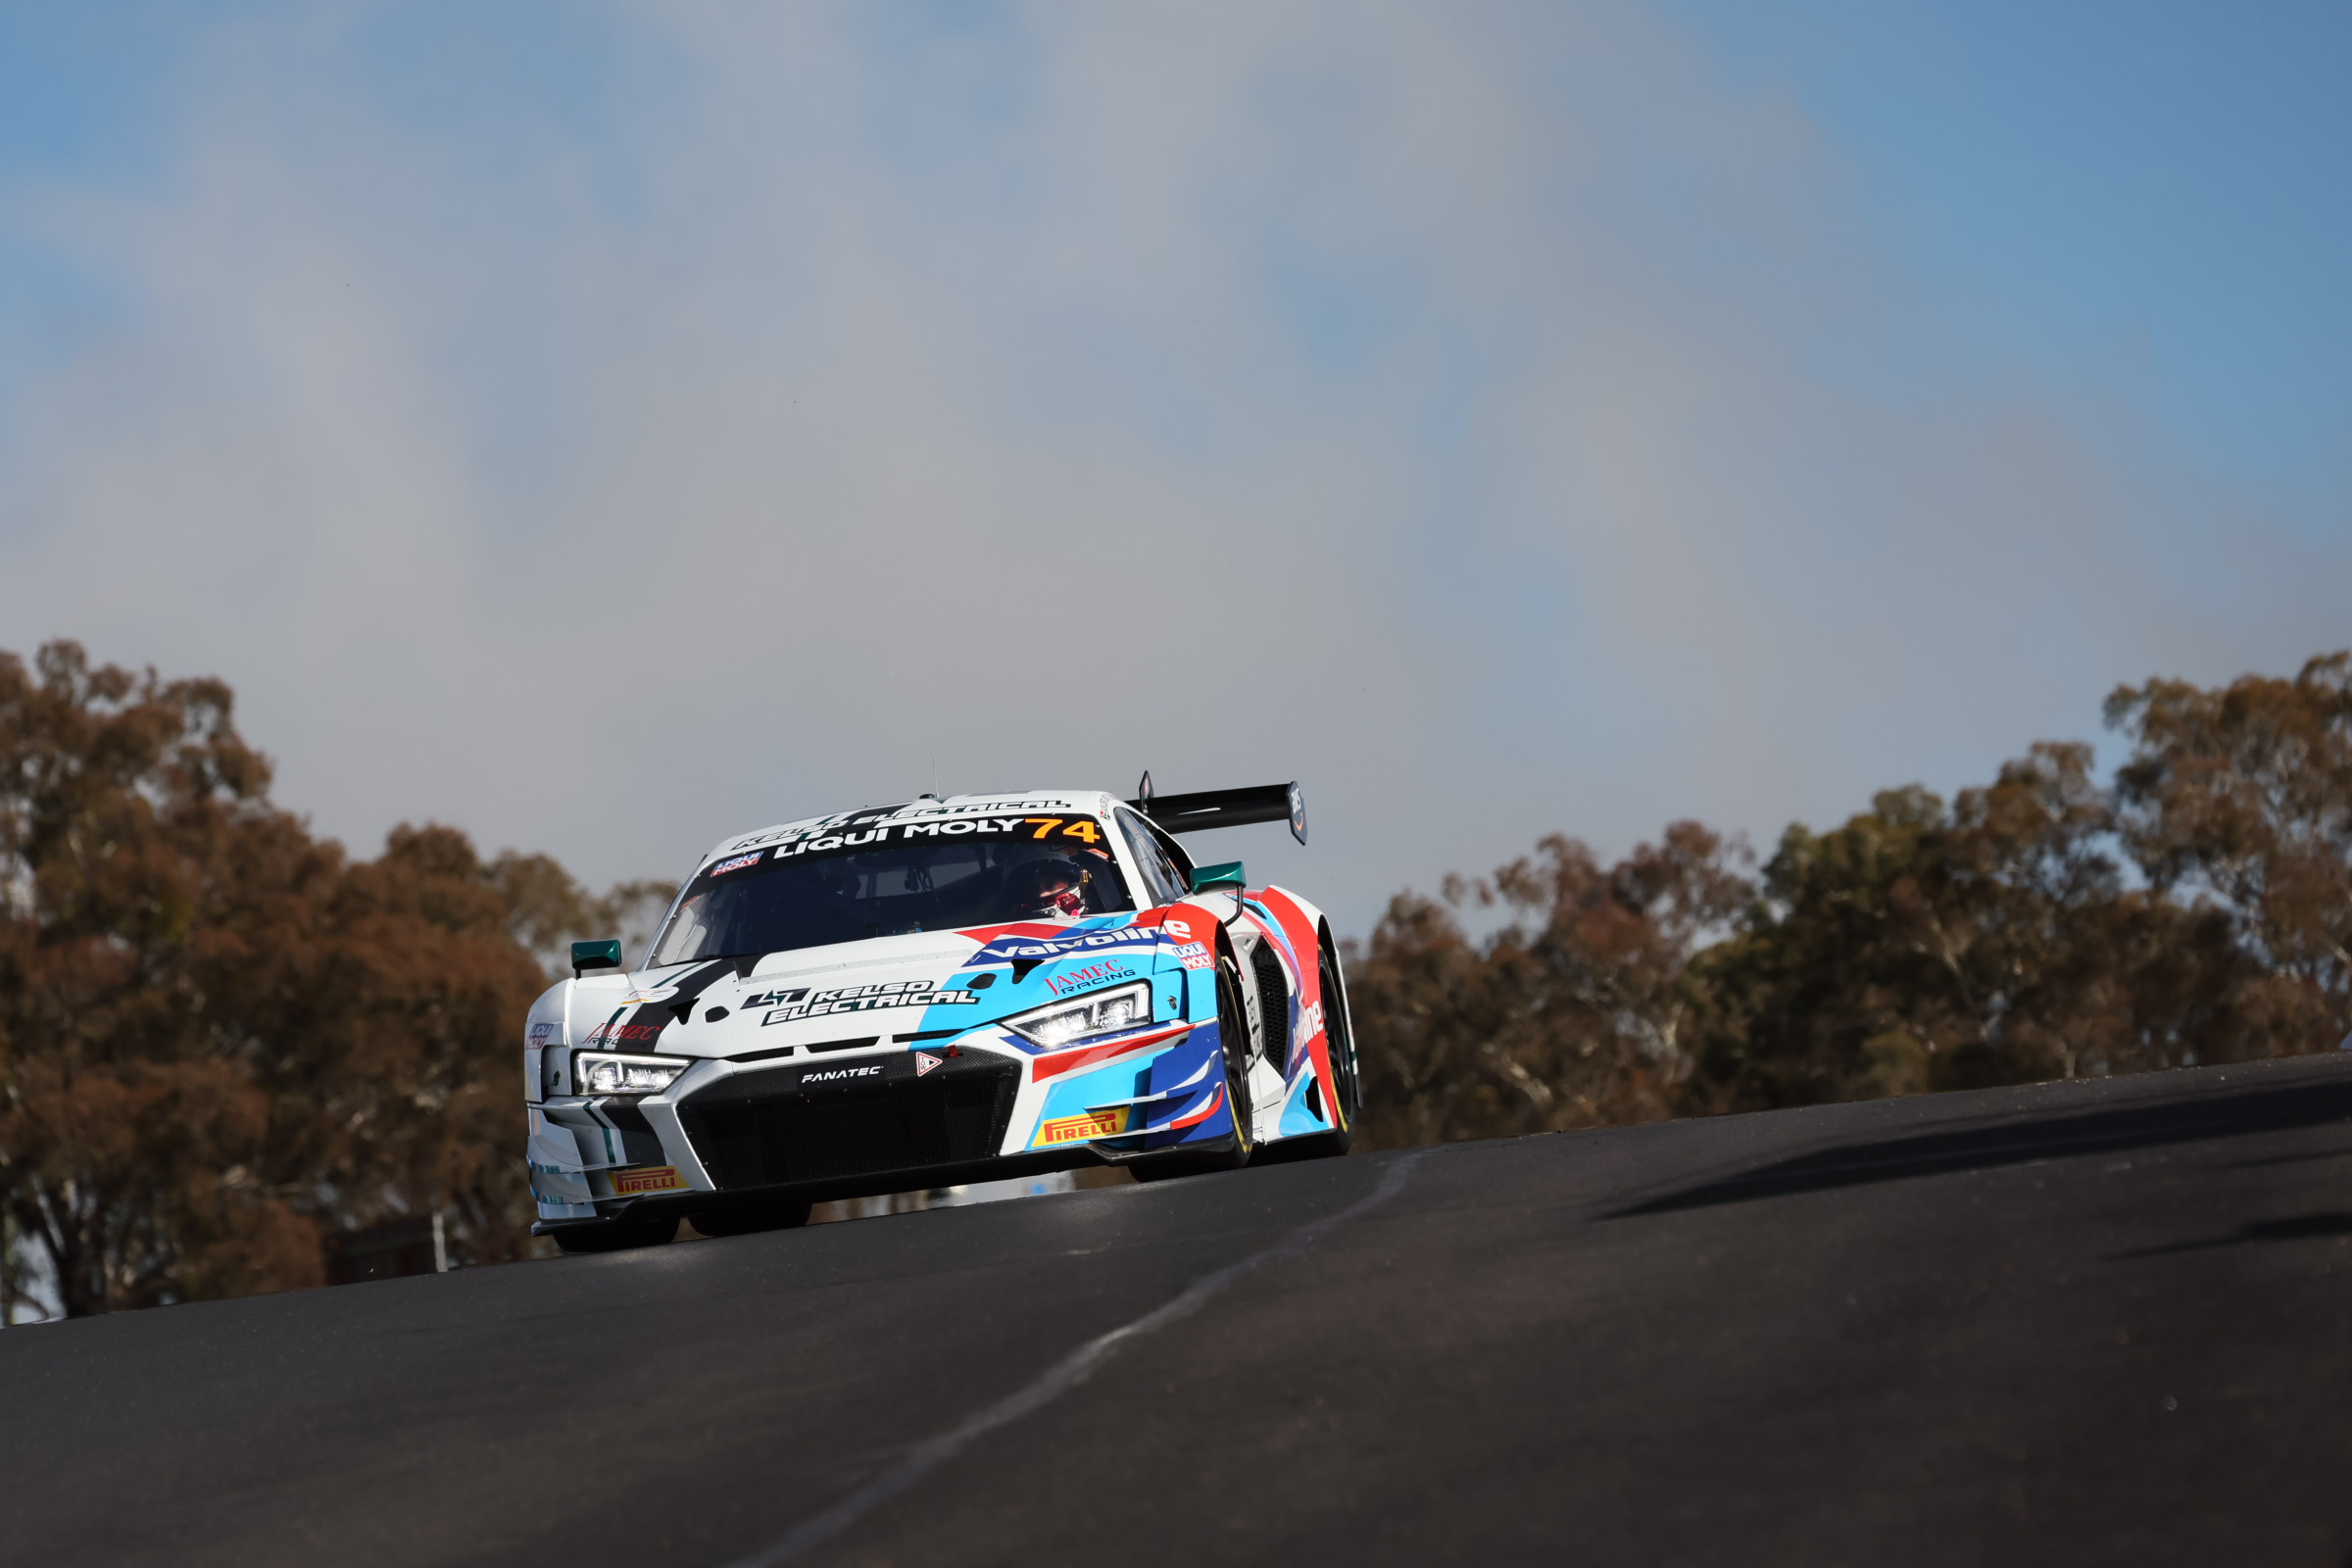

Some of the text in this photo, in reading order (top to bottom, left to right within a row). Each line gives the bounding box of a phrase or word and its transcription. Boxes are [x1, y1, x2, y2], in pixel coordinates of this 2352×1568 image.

[730, 820, 849, 851] KELSO
[853, 801, 1071, 825] ELECTRICAL
[774, 817, 1024, 858] LIQUI MOLY
[1025, 817, 1101, 844] 74
[713, 858, 759, 876] MOLY
[716, 851, 762, 870] LIQUI
[982, 919, 1192, 957] Valvoline
[1174, 943, 1206, 958] LIQUI
[1181, 954, 1212, 970] MOLY
[1045, 958, 1125, 997] JAMEC
[1061, 969, 1136, 995] RACING
[814, 980, 934, 1004] KELSO
[761, 990, 980, 1026] ELECTRICAL
[582, 1022, 662, 1044] JAMEC
[802, 1065, 882, 1084] FANATEC
[1044, 1112, 1117, 1143] PIRELLI
[615, 1168, 676, 1193] PIRELLI
